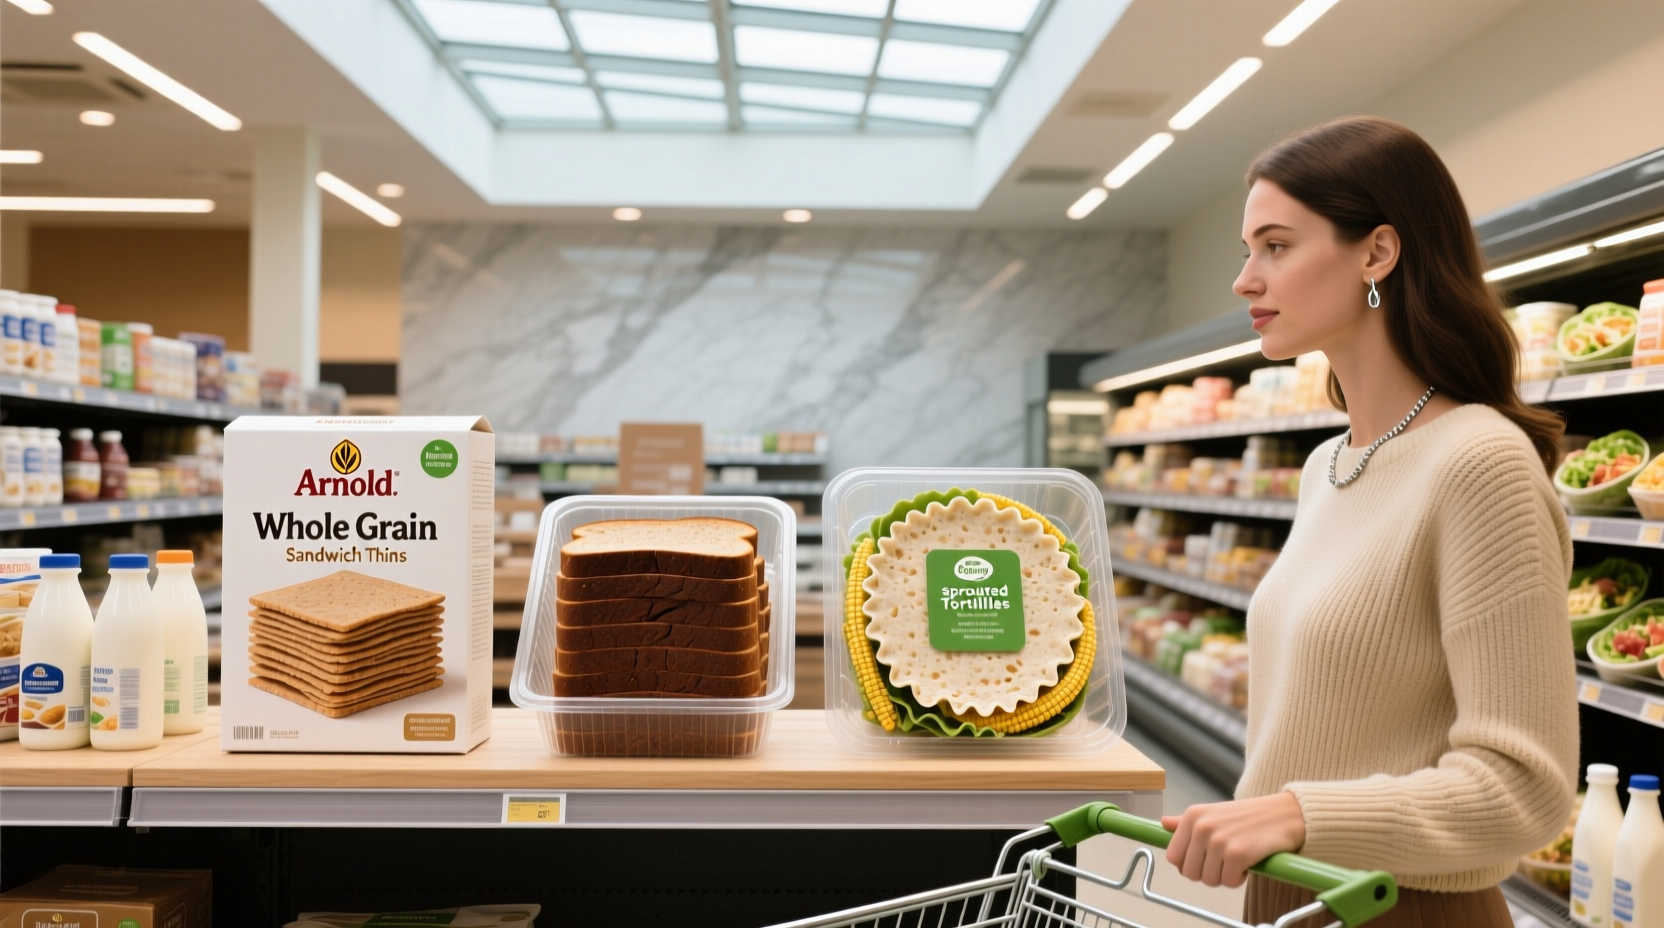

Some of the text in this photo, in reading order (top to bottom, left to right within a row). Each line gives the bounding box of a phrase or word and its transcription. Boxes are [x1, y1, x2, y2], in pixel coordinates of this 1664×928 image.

[252, 511, 438, 541] Whole Grain
[286, 546, 407, 563] Sandwich Thins
